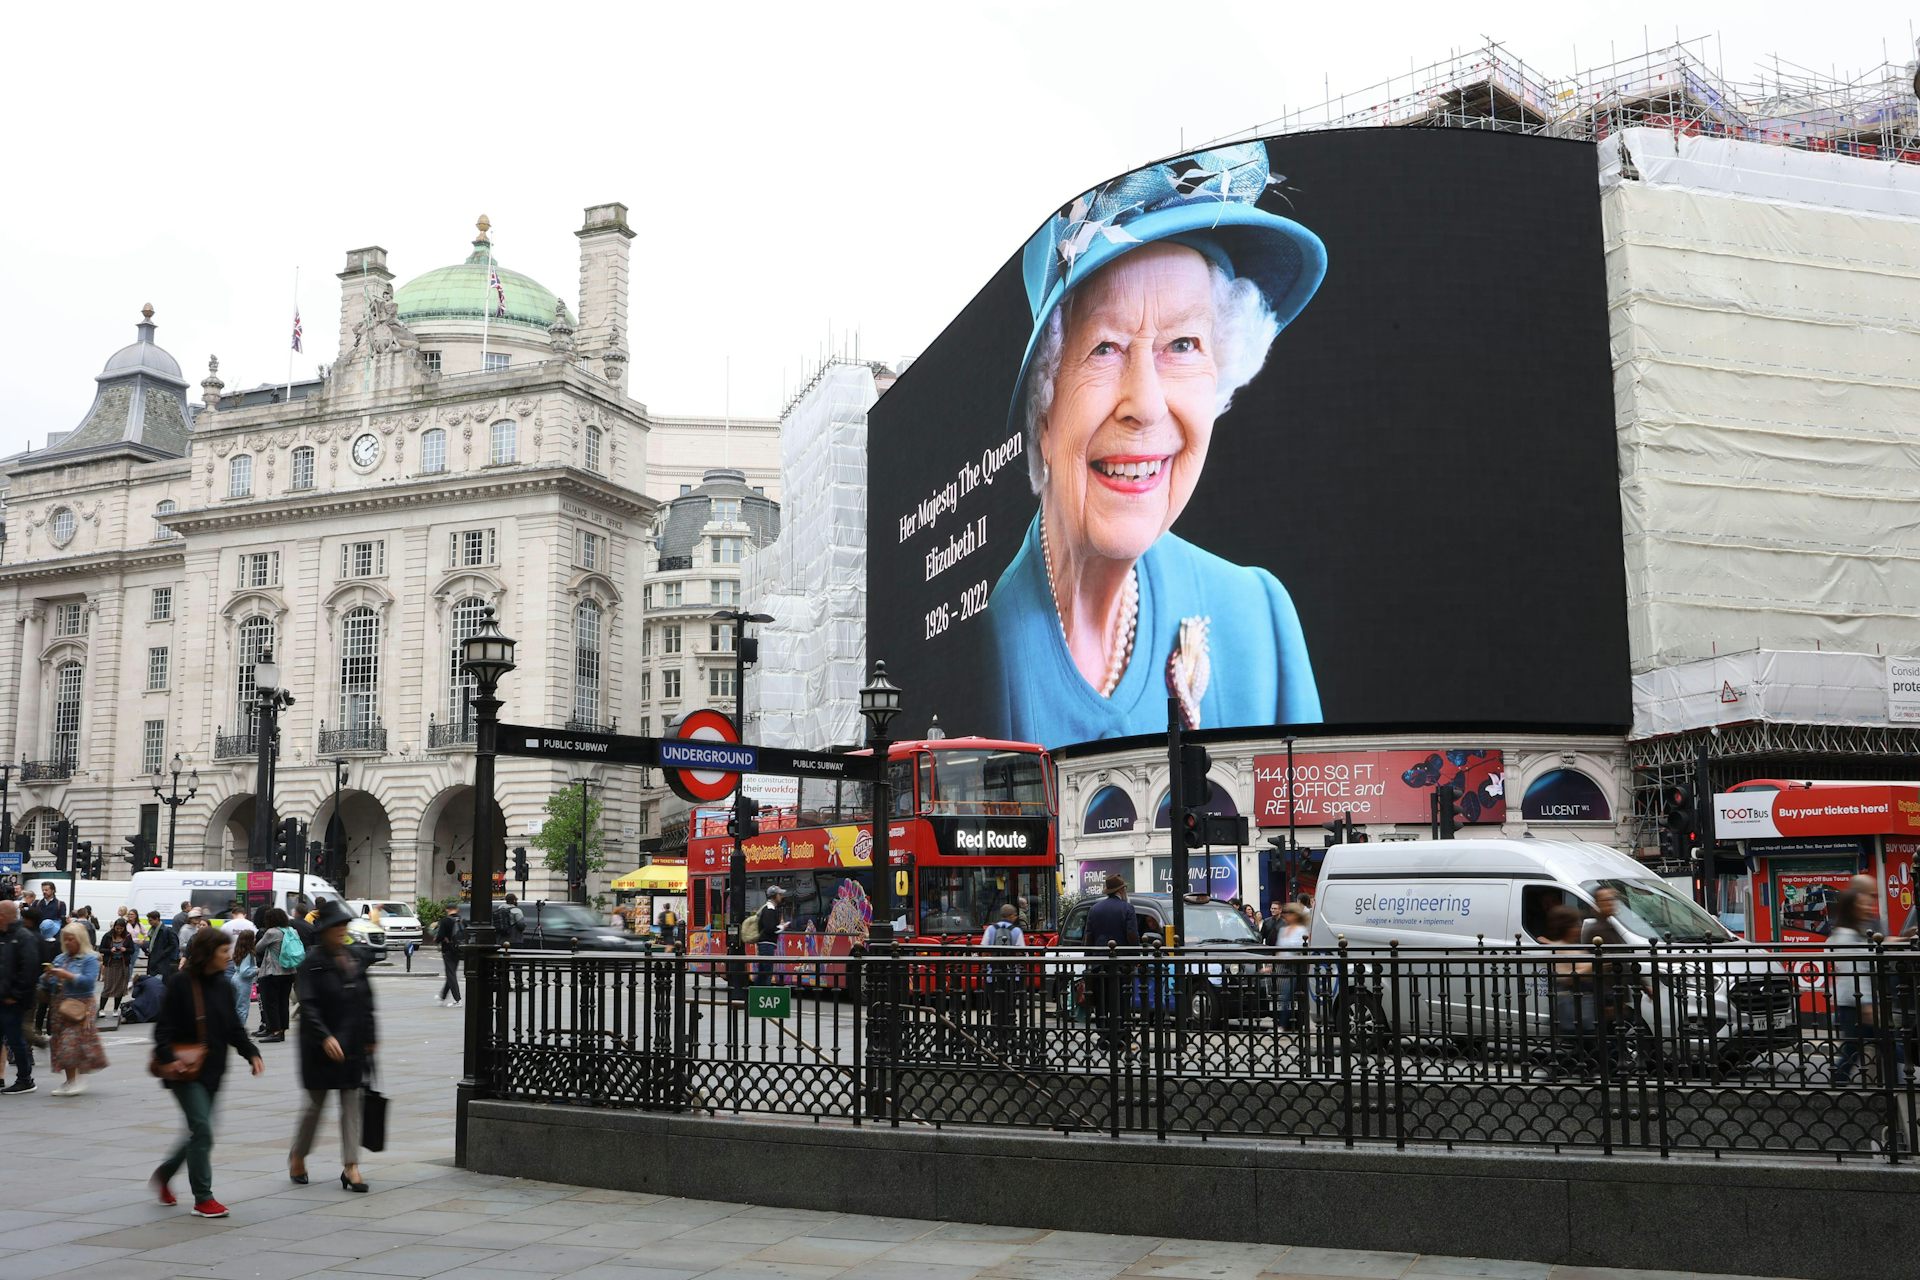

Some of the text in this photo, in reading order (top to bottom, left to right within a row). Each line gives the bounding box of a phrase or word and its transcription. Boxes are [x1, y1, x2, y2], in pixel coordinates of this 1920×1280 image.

[899, 431, 1023, 543] Her Majesty The Queen
[925, 515, 987, 582] Elizabeth II
[925, 602, 949, 640] 1926
[960, 579, 988, 621] 2022
[543, 738, 608, 752] PUBLIC SUBWAY
[663, 747, 753, 765] UNDERGROUND
[792, 759, 844, 771] PUBLIC SUBWAY
[1255, 764, 1374, 783] 144,000 SQ FT
[1273, 780, 1386, 799] of OFFICE and
[1322, 800, 1372, 817] space
[1541, 804, 1580, 816] LUCENT
[1779, 807, 1798, 819] Buy
[1799, 806, 1823, 819] your
[1824, 804, 1859, 816] tickets
[1860, 803, 1889, 815] here!
[1098, 818, 1123, 830] LUCENT
[956, 829, 1028, 849] Red Route
[1886, 843, 1898, 853] BUY
[1898, 843, 1915, 854] YOUR
[182, 879, 237, 887] POLICE
[1084, 870, 1106, 883] PRIME
[1355, 893, 1470, 917] gel engineering
[1423, 917, 1454, 926] implement
[1783, 935, 1795, 943] Buy
[758, 996, 781, 1009] SAP
